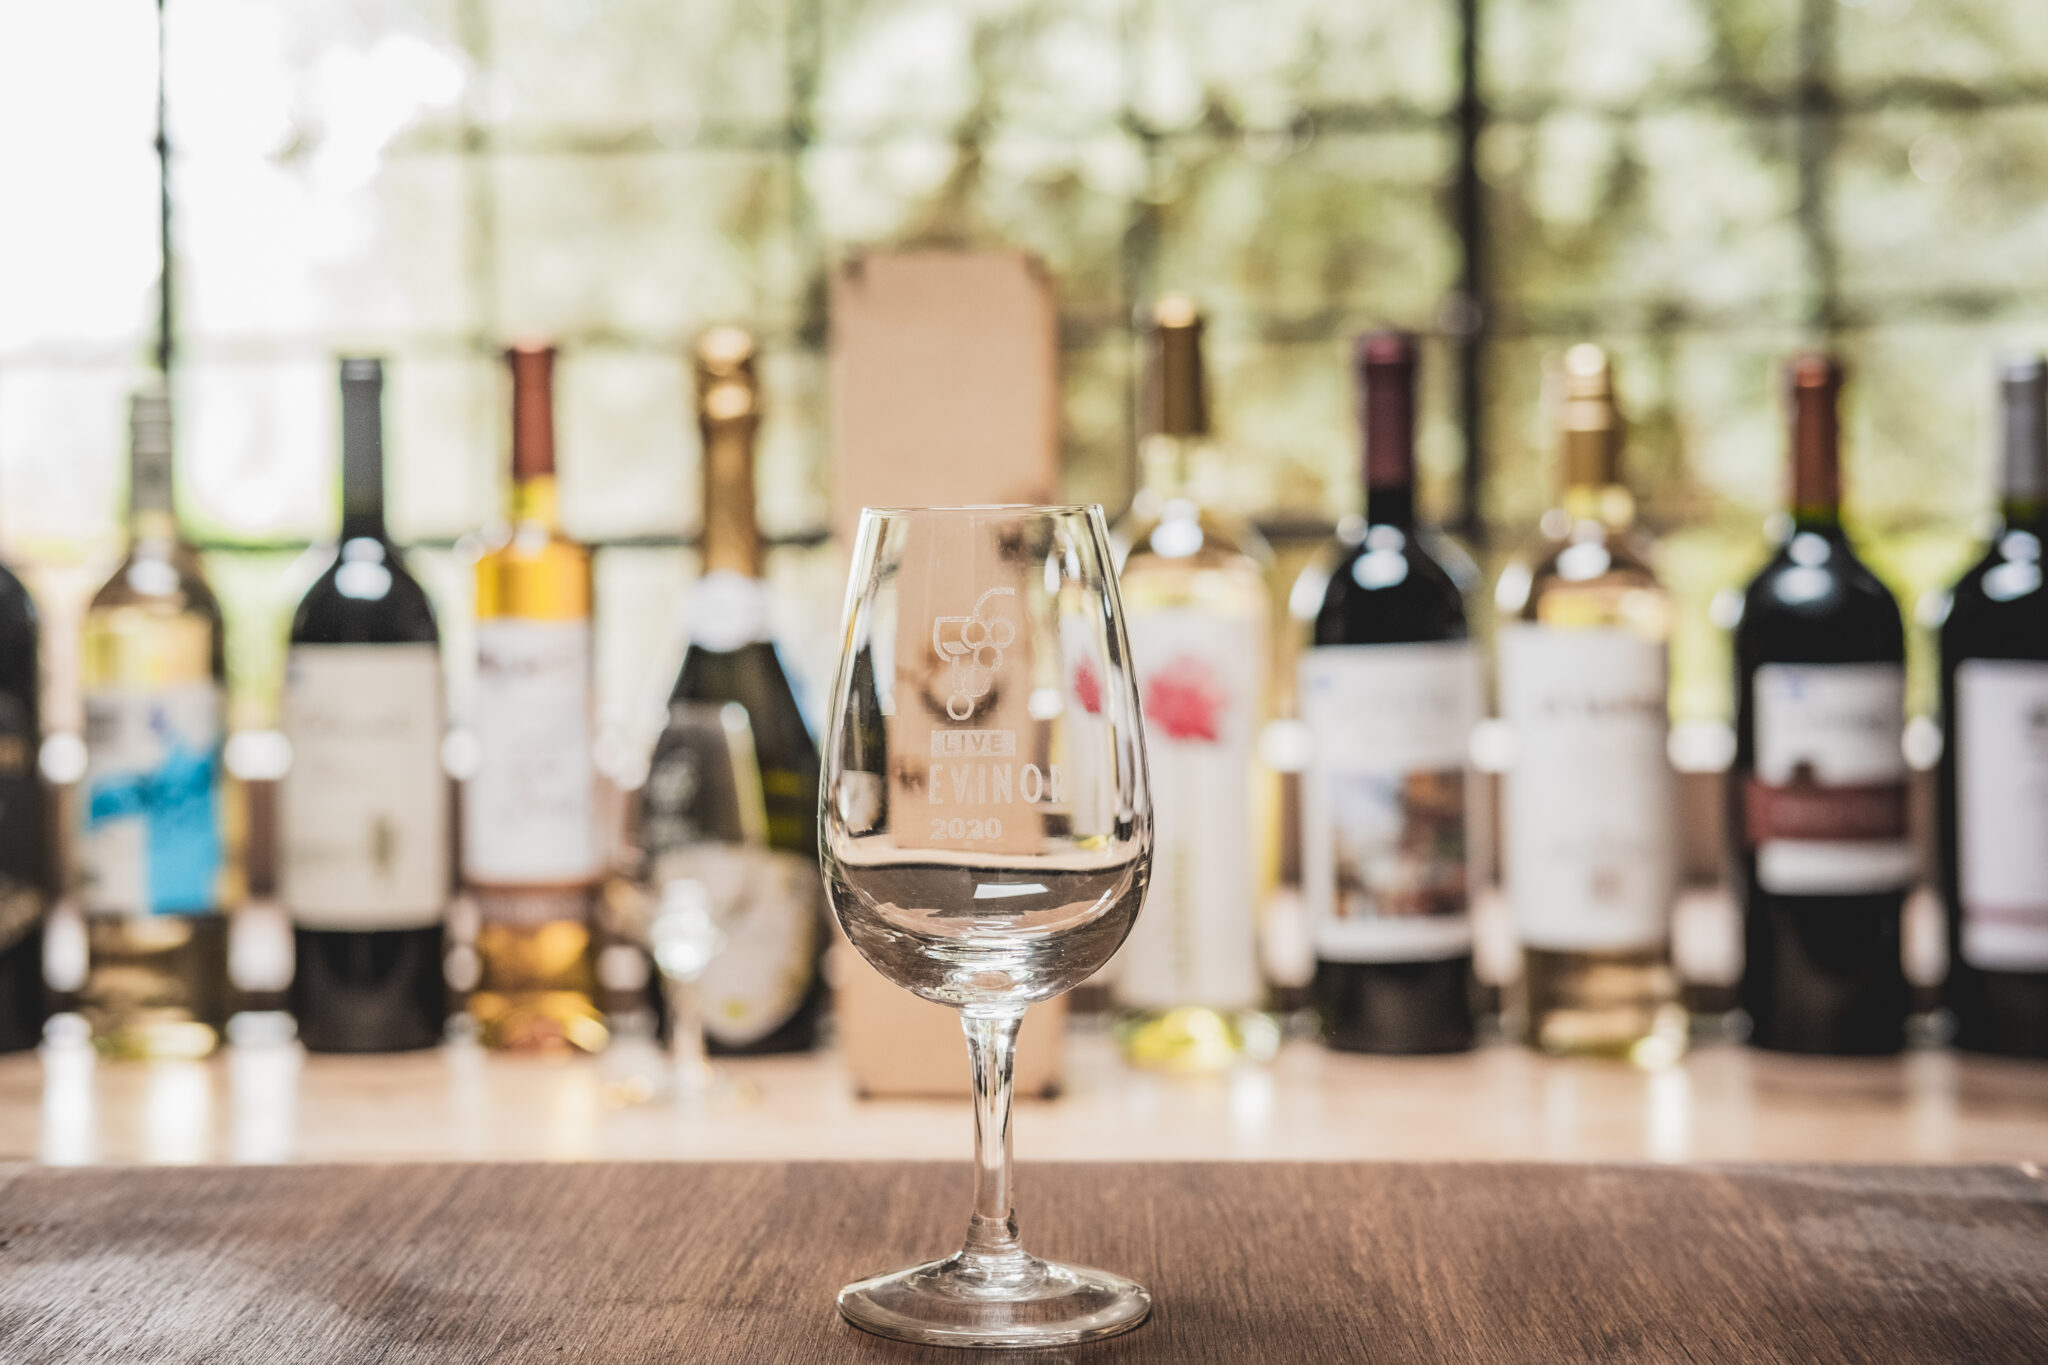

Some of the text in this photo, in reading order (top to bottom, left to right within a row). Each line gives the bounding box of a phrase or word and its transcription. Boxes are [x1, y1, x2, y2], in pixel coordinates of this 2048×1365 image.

[943, 734, 1003, 751] LIVE
[929, 763, 1066, 804] EVINOR
[930, 817, 1002, 840] 2020
